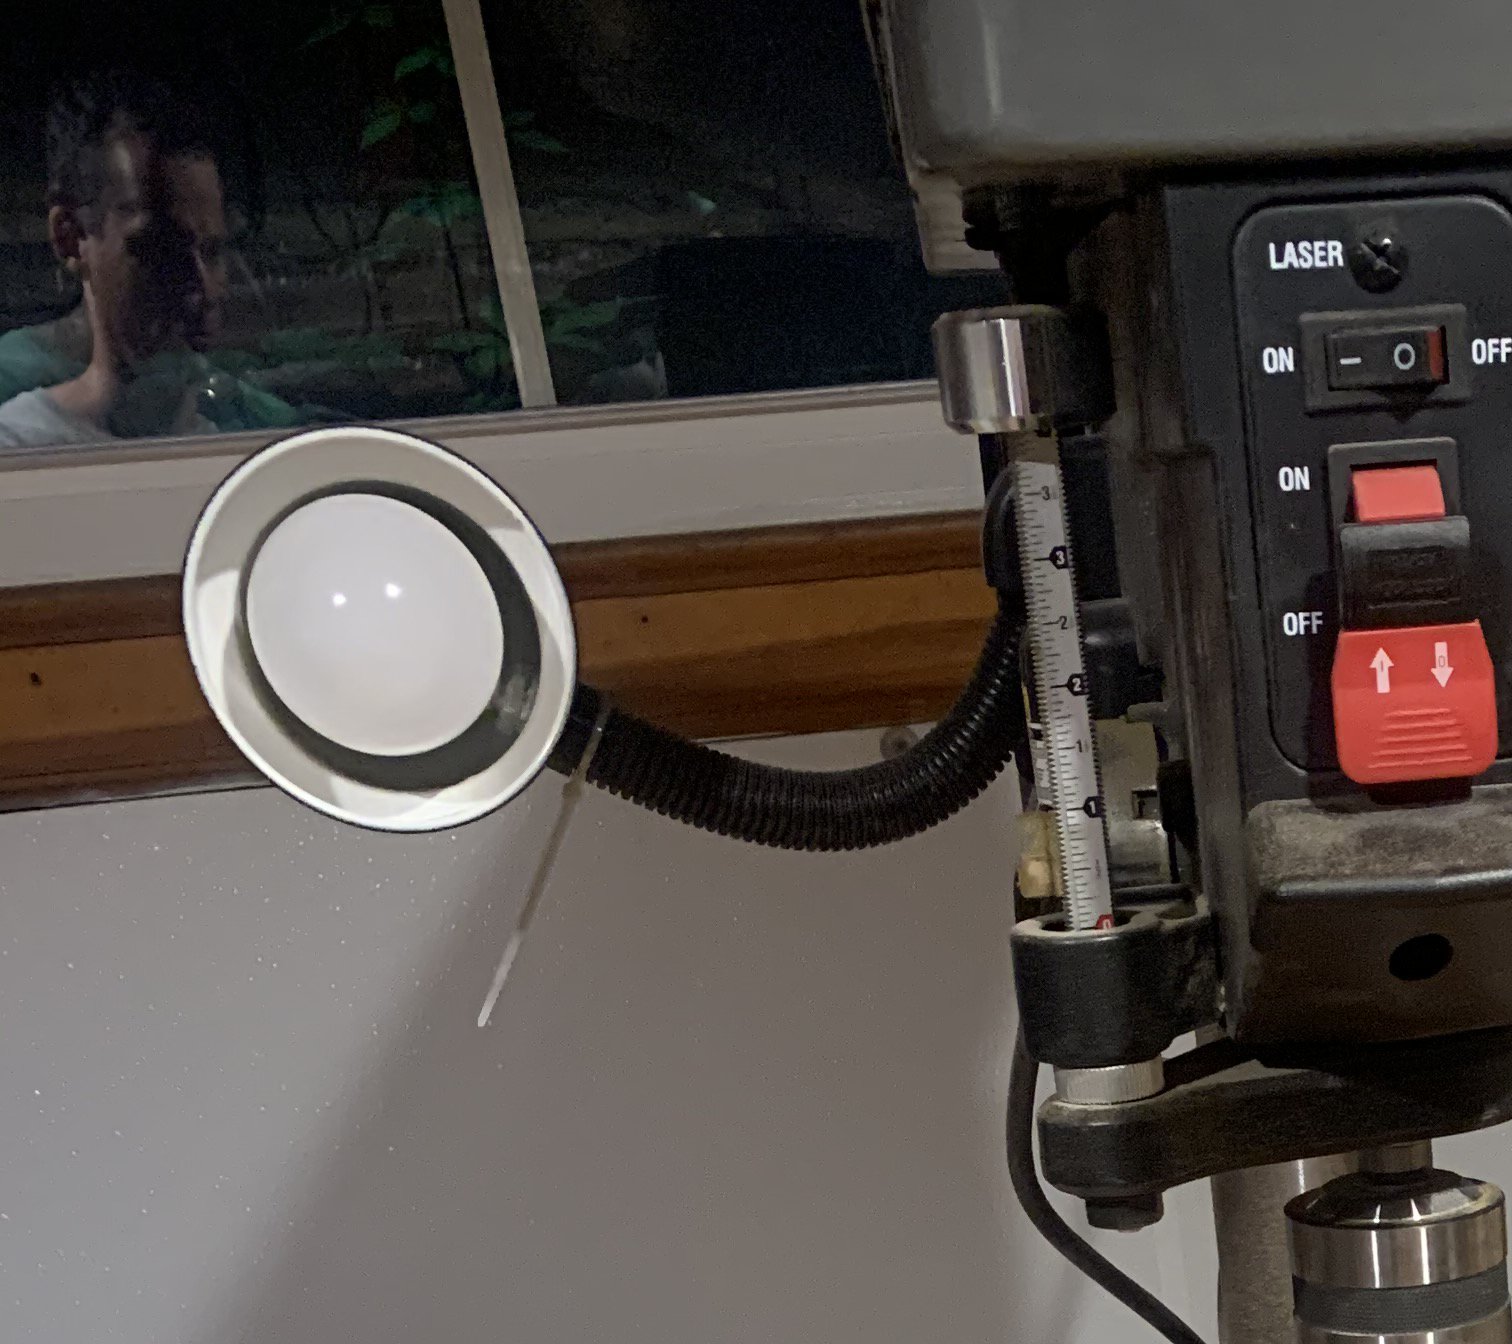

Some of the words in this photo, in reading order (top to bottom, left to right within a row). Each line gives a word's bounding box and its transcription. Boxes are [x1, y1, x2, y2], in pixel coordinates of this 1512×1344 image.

[1268, 240, 1344, 270] LASER
[1262, 346, 1295, 373] ON
[1471, 337, 1512, 365] OFF
[1278, 466, 1311, 491] ON
[1056, 550, 1065, 565] 3
[1283, 611, 1324, 636] OFF
[1073, 678, 1082, 692] 2
[1088, 801, 1096, 814] 1
